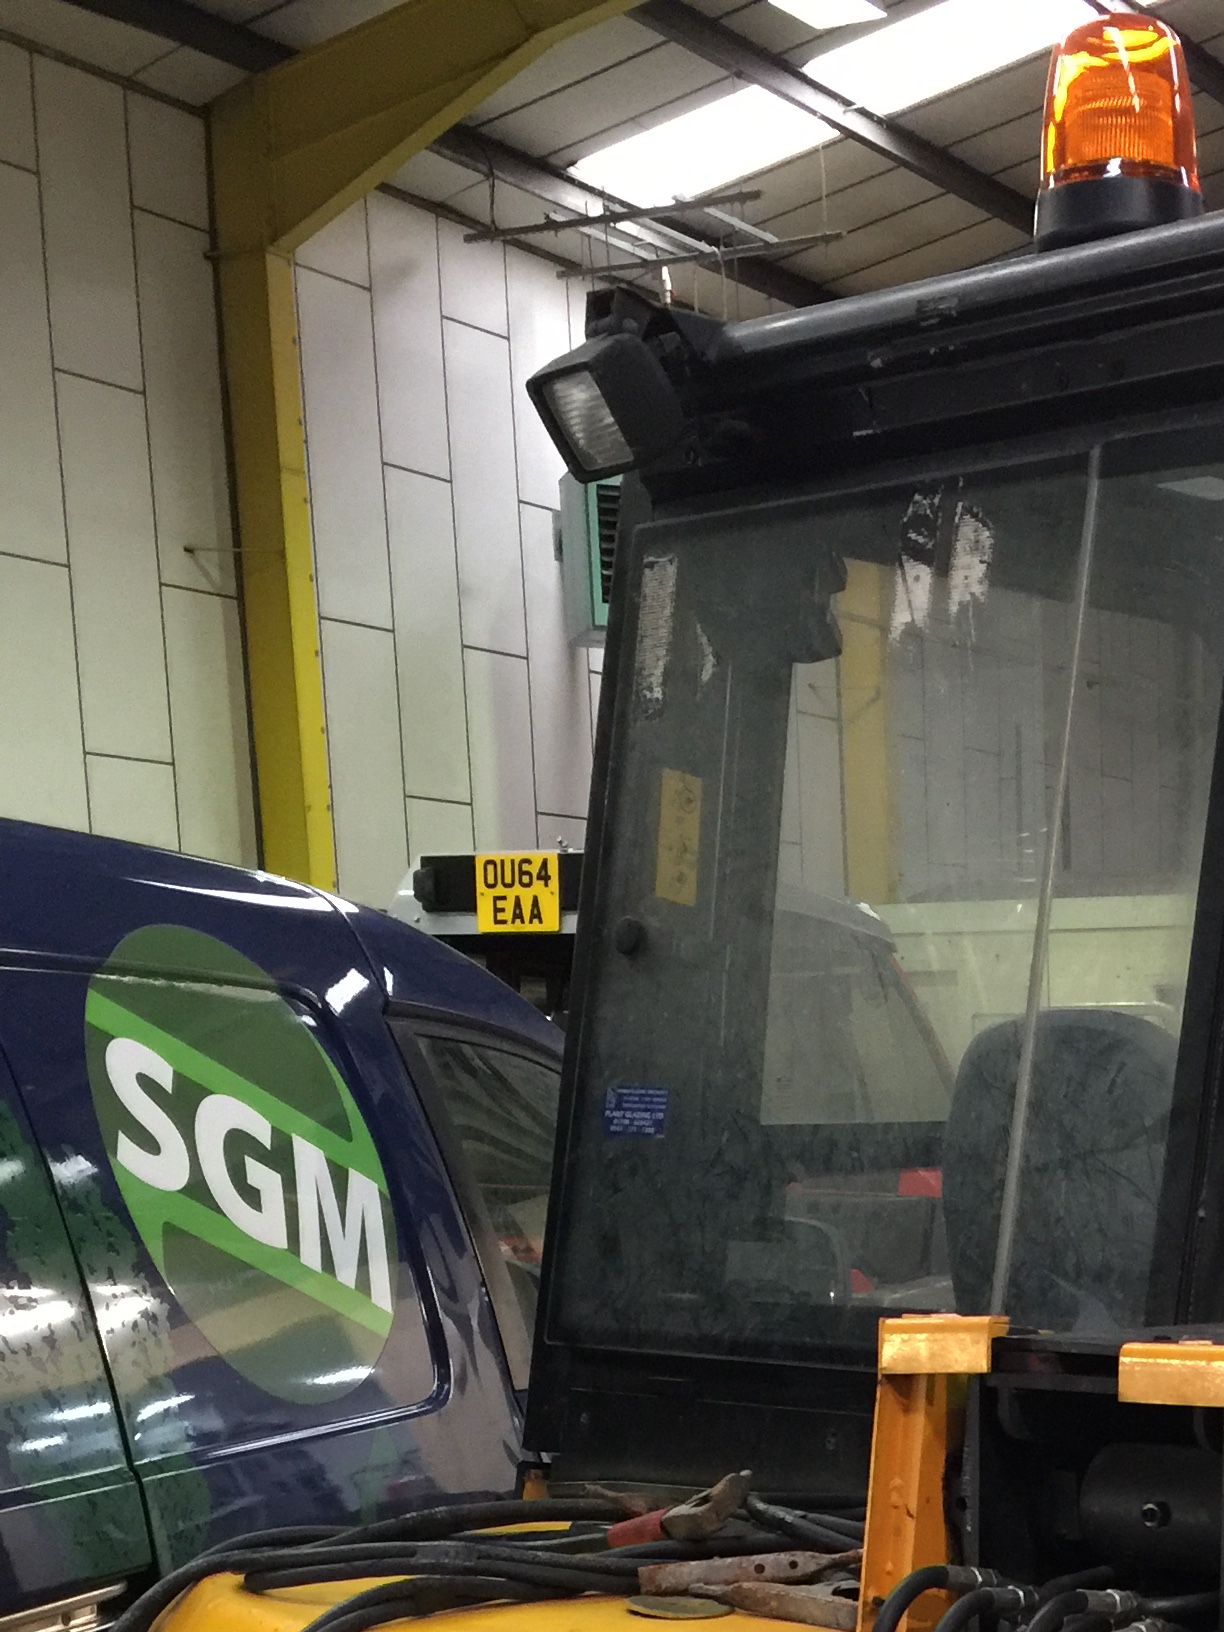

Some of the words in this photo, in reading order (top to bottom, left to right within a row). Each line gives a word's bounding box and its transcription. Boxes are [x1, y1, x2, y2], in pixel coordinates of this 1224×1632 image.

[483, 858, 551, 889] OU64
[493, 894, 543, 925] EAA
[105, 1037, 393, 1314] SGM
